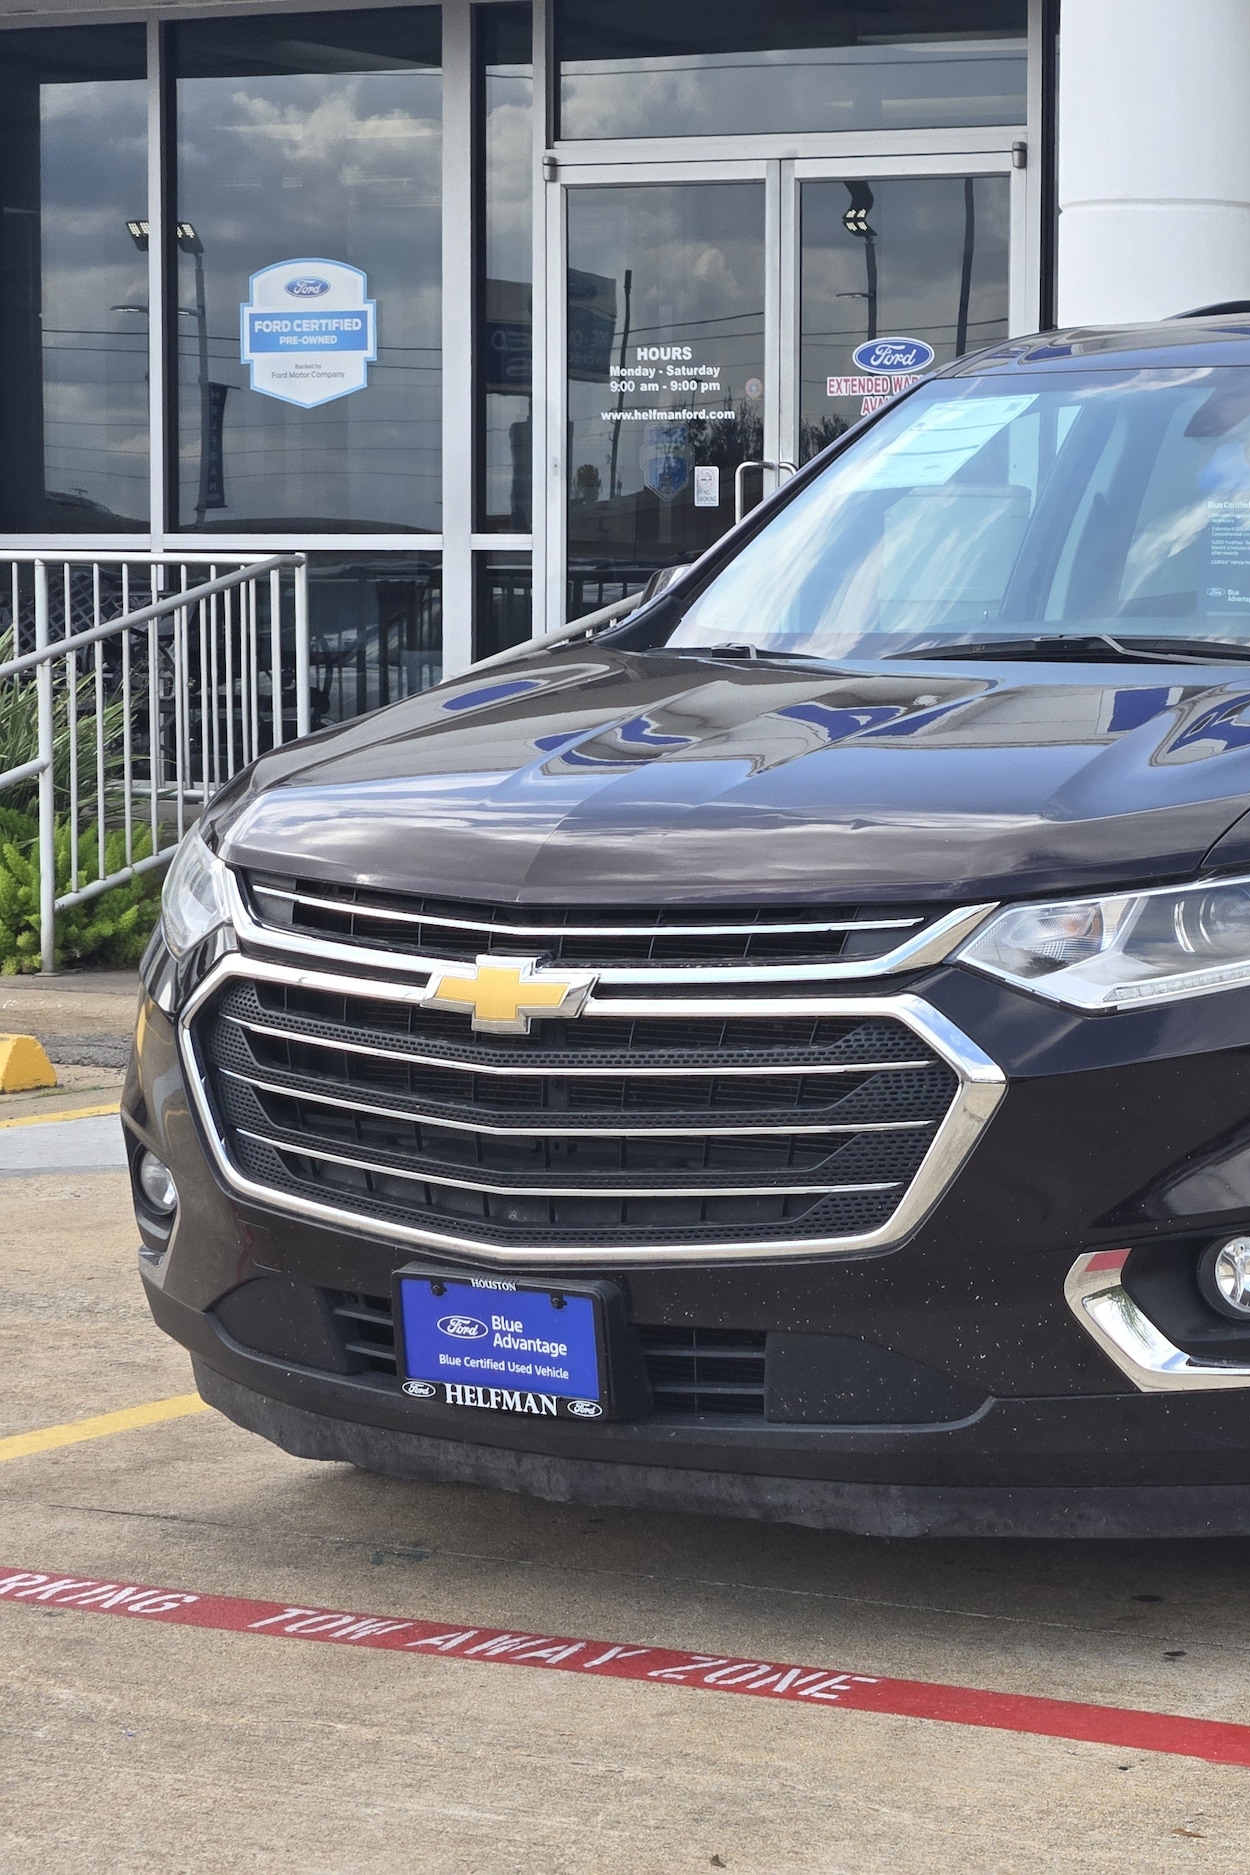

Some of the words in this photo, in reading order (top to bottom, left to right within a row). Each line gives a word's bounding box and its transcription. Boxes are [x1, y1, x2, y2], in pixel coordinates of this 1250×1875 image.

[254, 320, 292, 333] FORD
[293, 318, 362, 332] CERTIFIED
[279, 335, 338, 345] PRE-OWNED
[636, 346, 693, 361] HOURS
[271, 371, 288, 379] Ford
[289, 371, 310, 379] Motor
[311, 370, 345, 379] Company
[609, 366, 656, 379] Monday
[666, 365, 721, 378] Saturday
[610, 381, 635, 392] 9:00
[640, 383, 660, 392] am
[670, 380, 698, 391] 9:00
[701, 382, 721, 393] pm
[827, 377, 890, 395] EXTENDED
[601, 408, 736, 421] www.helfmanford.com
[470, 1278, 517, 1292] HOUSTON
[491, 1315, 523, 1333] Blue
[493, 1334, 567, 1357] Advantage
[439, 1353, 461, 1366] Blue
[463, 1356, 505, 1371] Certified
[508, 1361, 532, 1375] Used
[535, 1365, 569, 1379] Vehicle
[444, 1383, 557, 1416] HELFMAN
[247, 1608, 414, 1640] TOW
[405, 1629, 650, 1668] AWAY
[647, 1656, 878, 1699] ZONE
